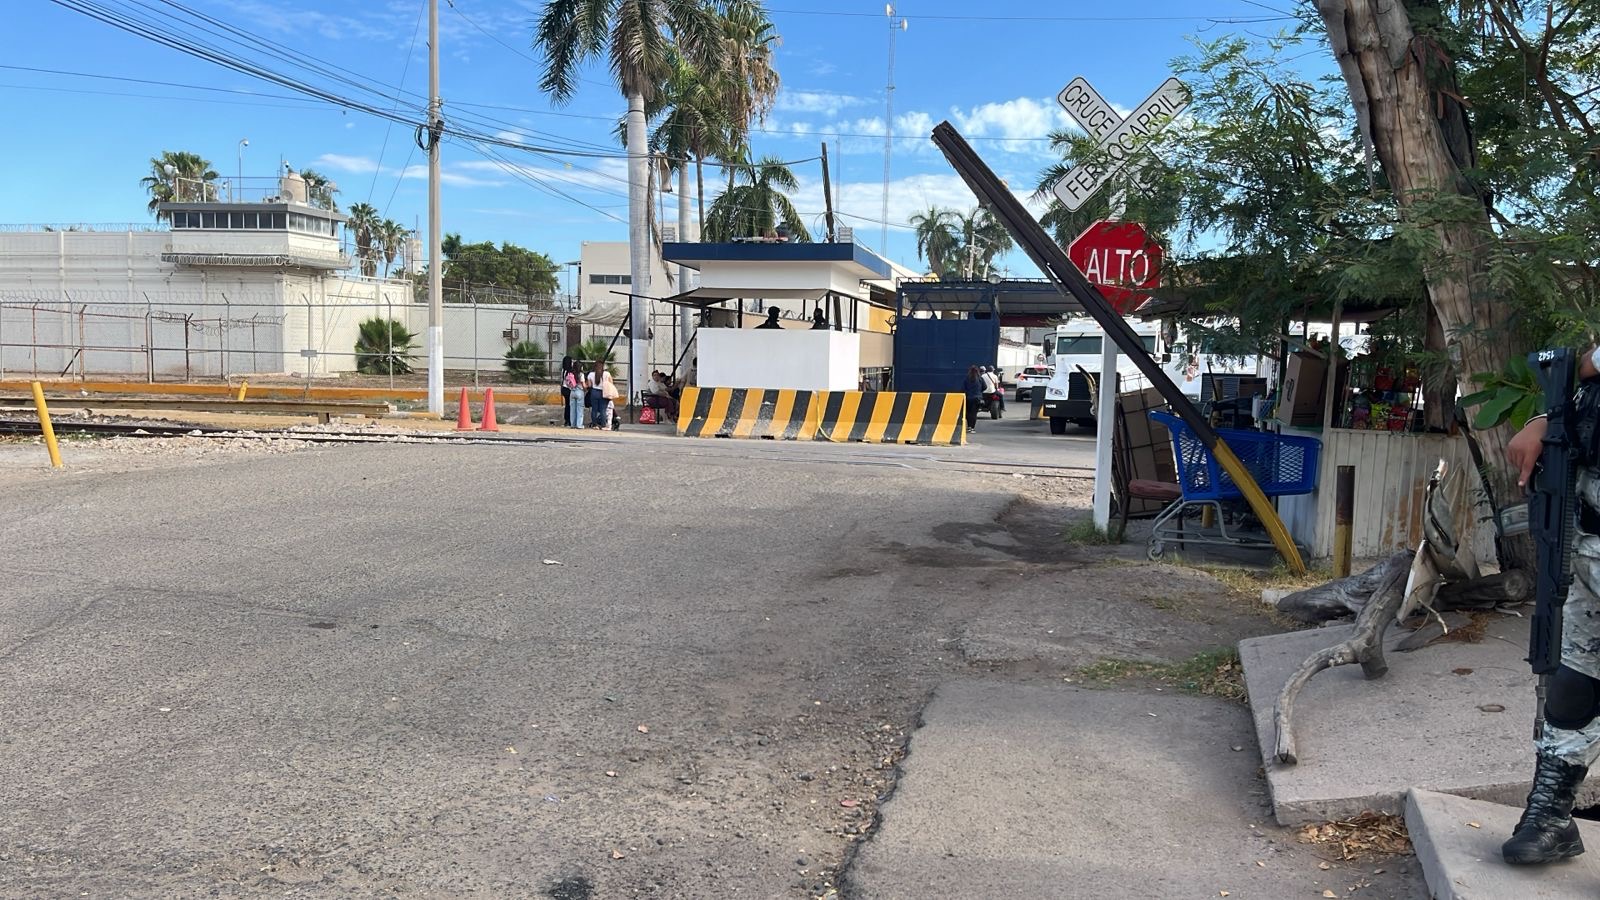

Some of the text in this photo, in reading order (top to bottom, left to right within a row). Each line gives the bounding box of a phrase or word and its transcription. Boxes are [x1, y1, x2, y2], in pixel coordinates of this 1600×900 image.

[1064, 85, 1115, 137] CRUCE
[1086, 248, 1149, 286] ALTO
[1538, 350, 1555, 361] 1542
